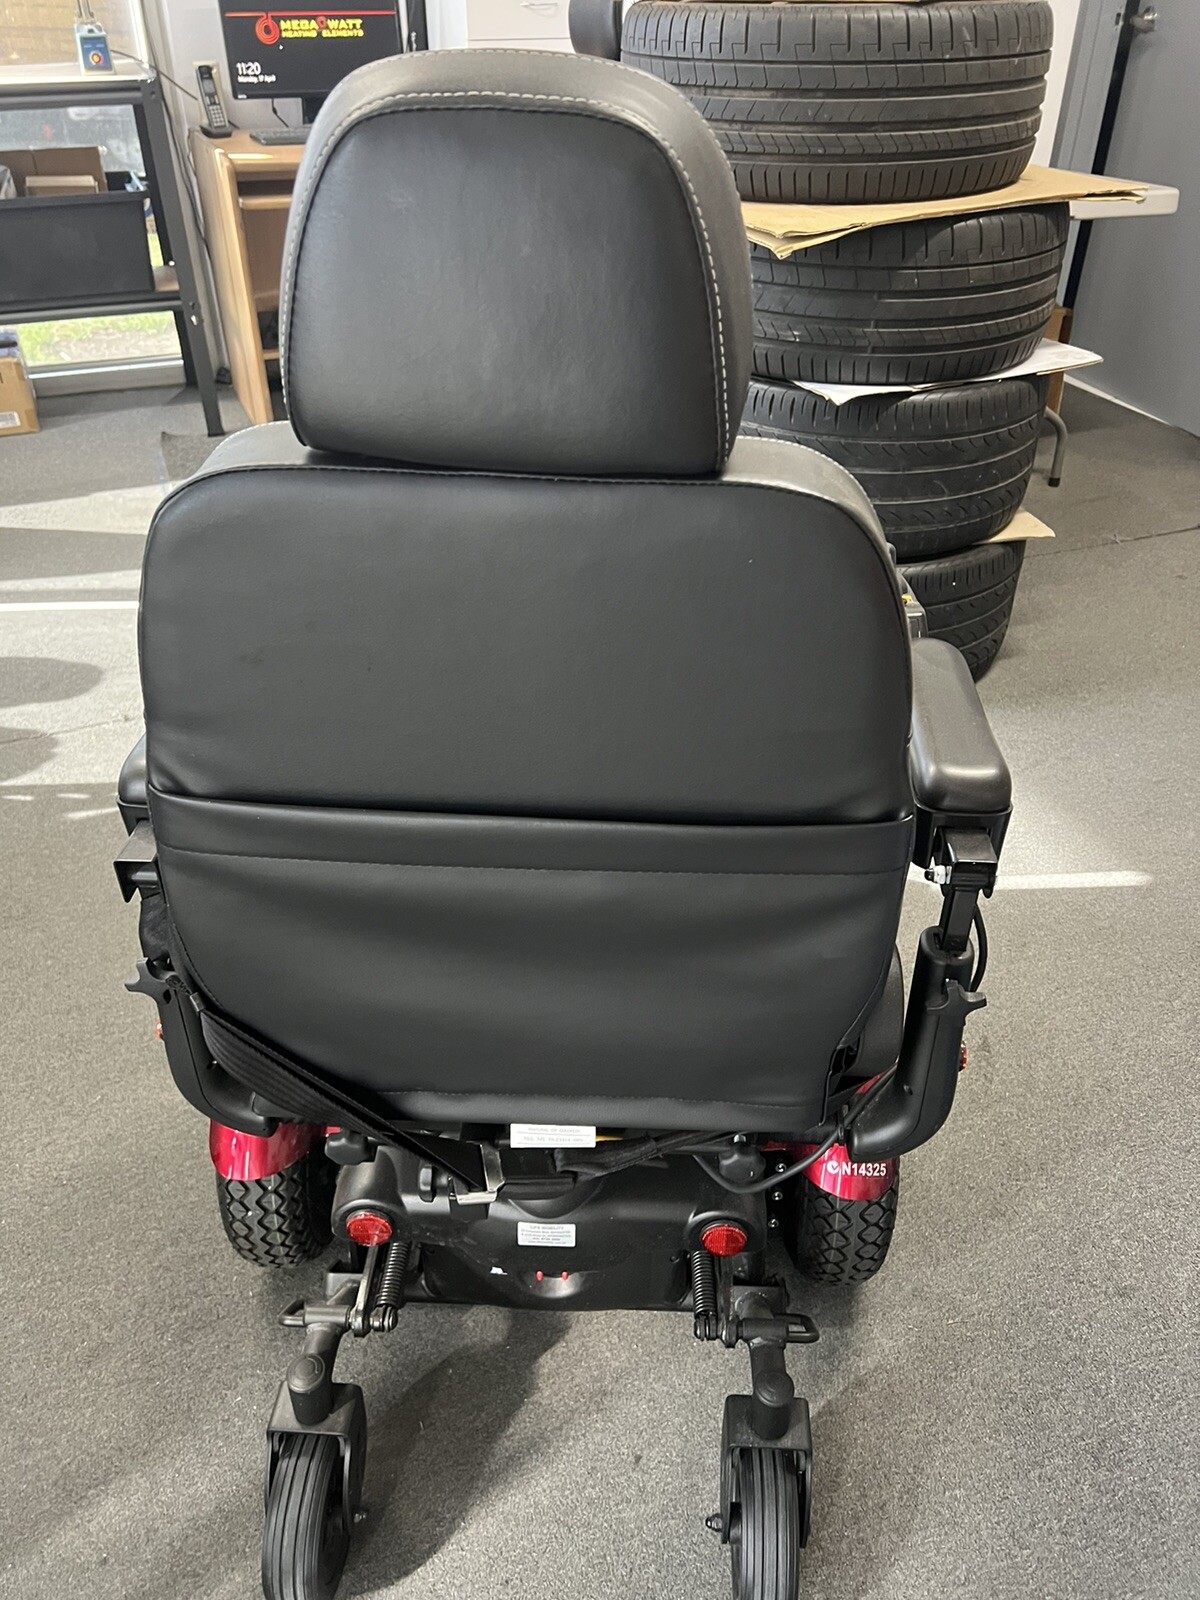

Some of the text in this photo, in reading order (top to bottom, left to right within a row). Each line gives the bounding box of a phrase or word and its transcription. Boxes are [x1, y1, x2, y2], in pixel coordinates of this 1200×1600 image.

[280, 18, 362, 30] MEGA WATT
[281, 29, 364, 38] HEATING ELEMENTS
[236, 61, 262, 76] 11:20
[842, 1161, 887, 1177] N14325
